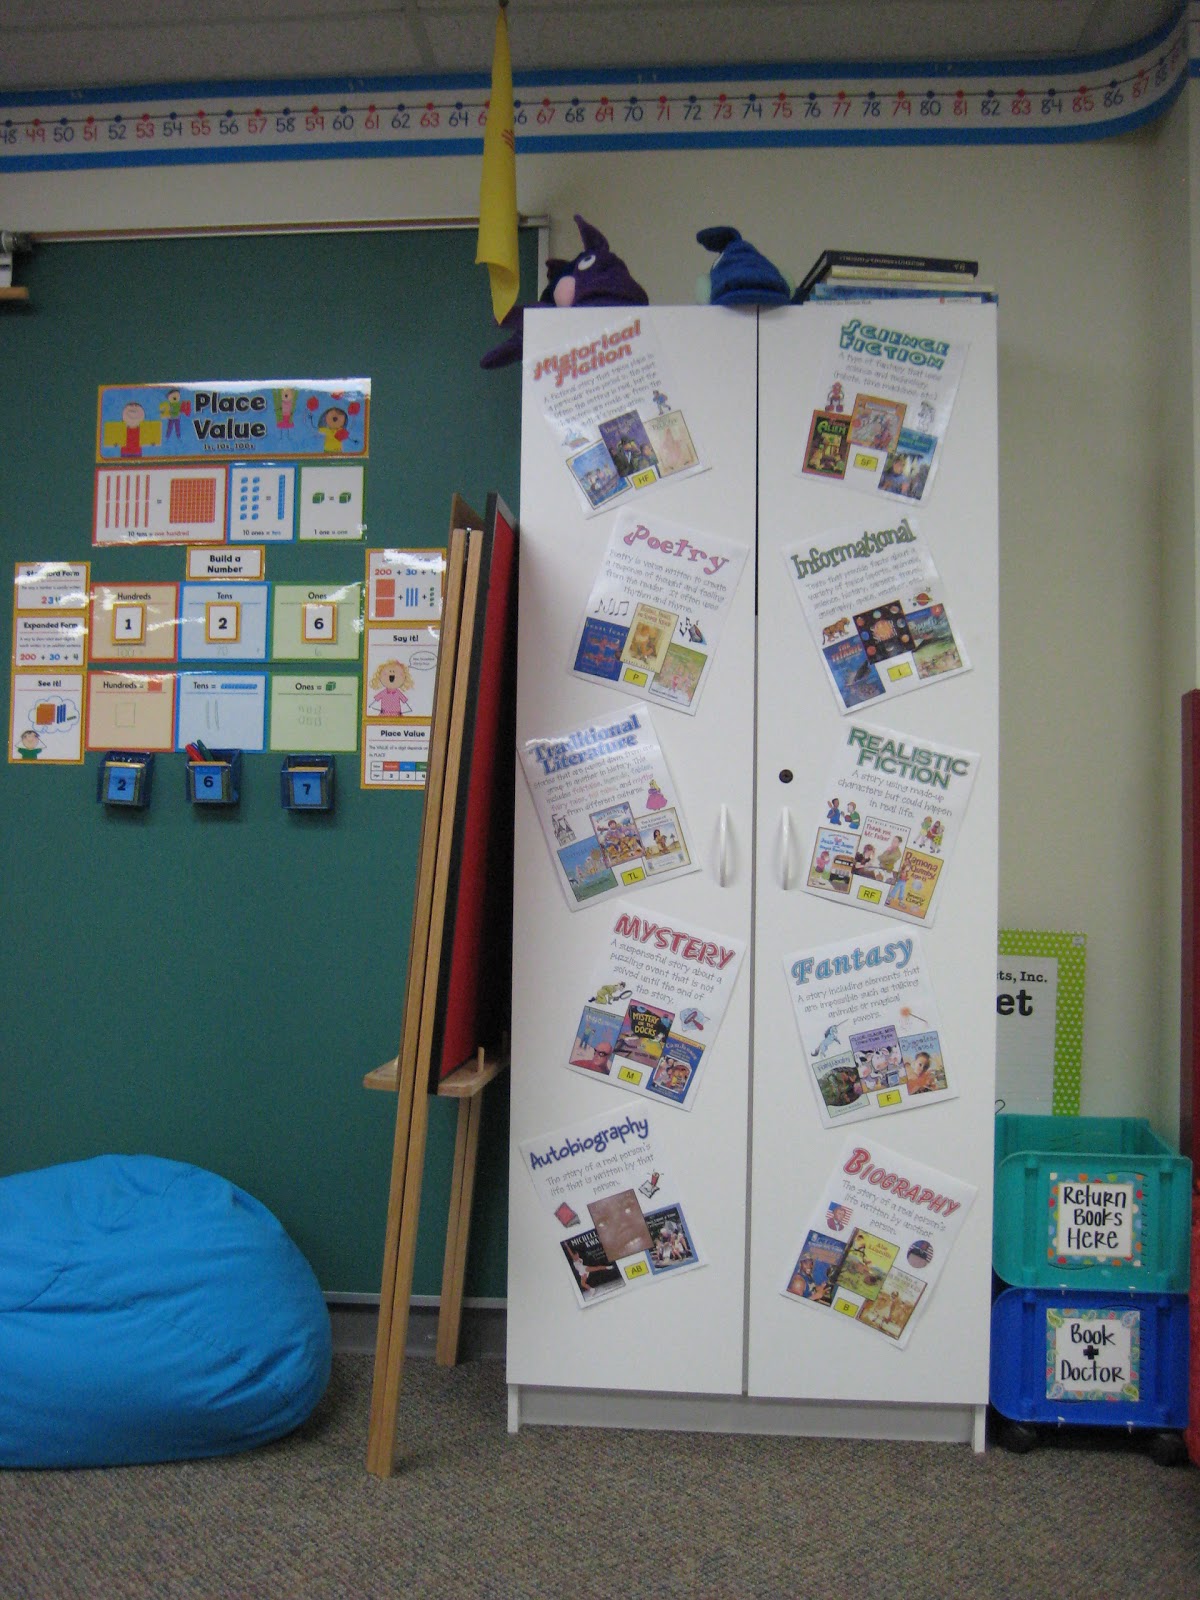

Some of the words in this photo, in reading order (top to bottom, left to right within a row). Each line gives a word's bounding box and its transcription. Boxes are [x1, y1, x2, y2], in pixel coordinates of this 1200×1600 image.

[0, 129, 17, 144] 48
[26, 128, 46, 144] 49
[53, 126, 74, 143] 50
[83, 124, 98, 141] 51
[108, 124, 127, 140] 52
[136, 120, 155, 138] 53
[163, 118, 183, 136] 54
[191, 117, 211, 135] 55
[219, 117, 239, 134] 56
[247, 117, 267, 134] 57
[276, 117, 296, 133] 58
[305, 114, 325, 131] 59
[332, 114, 354, 130] 60
[364, 113, 380, 129] 61
[391, 112, 410, 129] 62
[420, 111, 440, 128] 63
[449, 110, 468, 128] 64
[536, 109, 556, 125] 67
[565, 107, 586, 123] 68
[595, 107, 614, 122] 69
[623, 106, 643, 122] 70
[656, 105, 670, 121] 71
[683, 104, 702, 121] 72
[713, 103, 733, 119] 73
[741, 103, 763, 119] 74
[771, 101, 792, 118] 75
[804, 101, 821, 117] 76
[833, 102, 851, 117] 77
[862, 101, 881, 117] 78
[892, 101, 912, 116] 79
[920, 101, 941, 117] 80
[953, 100, 968, 116] 81
[980, 100, 1000, 116] 82
[1011, 99, 1031, 115] 83
[1040, 98, 1062, 115] 84
[1073, 95, 1094, 112] 85
[194, 391, 267, 414] Place
[192, 418, 267, 440] Value
[860, 458, 870, 467] SF
[638, 474, 650, 485] HF
[623, 525, 730, 575] Poetry
[791, 518, 917, 580] Informational
[209, 555, 233, 563] Build
[207, 565, 243, 574] Number
[405, 568, 418, 576] 30
[117, 592, 152, 601] Hundreds
[217, 592, 233, 600] Tens
[308, 592, 327, 600] Ones
[24, 622, 59, 630] Expanded
[125, 618, 132, 631] 1
[218, 617, 228, 629] 2
[314, 618, 324, 630] 6
[393, 634, 408, 643] Say
[20, 653, 37, 661] 200
[49, 653, 61, 661] 30
[73, 653, 79, 661] 4
[37, 680, 51, 688] See
[103, 682, 138, 690] Hundreds
[194, 682, 209, 690] Tens
[295, 682, 314, 691] Ones
[847, 726, 970, 777] REALISTIC
[856, 749, 951, 790] FICTION
[117, 778, 126, 791] 2
[203, 776, 214, 788] 6
[861, 773, 884, 786] story
[302, 783, 312, 795] 7
[885, 791, 900, 801] but
[628, 872, 638, 880] TL
[863, 890, 876, 899] RF
[614, 912, 737, 971] MYSTERY
[610, 939, 617, 947] A
[668, 960, 690, 972] story
[692, 967, 715, 980] about
[791, 938, 914, 986] Fantasy
[610, 952, 643, 969] puzzling
[672, 971, 690, 984] that
[691, 978, 698, 987] is
[700, 983, 715, 993] not
[997, 971, 1017, 983] ts,
[1020, 971, 1048, 983] Inc.
[613, 965, 638, 979] solved
[640, 974, 660, 986] until
[694, 993, 704, 1001] of
[806, 990, 827, 1001] story
[903, 966, 920, 977] that
[651, 990, 674, 1004] story.
[627, 1071, 634, 1079] M
[530, 1116, 649, 1170] Autobiography
[562, 1168, 583, 1180] story
[566, 1180, 583, 1191] that
[637, 1154, 654, 1166] that
[843, 1147, 961, 1217] BIOGRAPHY
[857, 1187, 877, 1203] story
[1062, 1184, 1127, 1209] Return
[1073, 1208, 1123, 1227] Books
[1067, 1228, 1119, 1250] Here
[631, 1266, 643, 1275] AB
[843, 1303, 850, 1311] B
[1071, 1324, 1116, 1346] Book
[1060, 1360, 1125, 1383] Doctor
